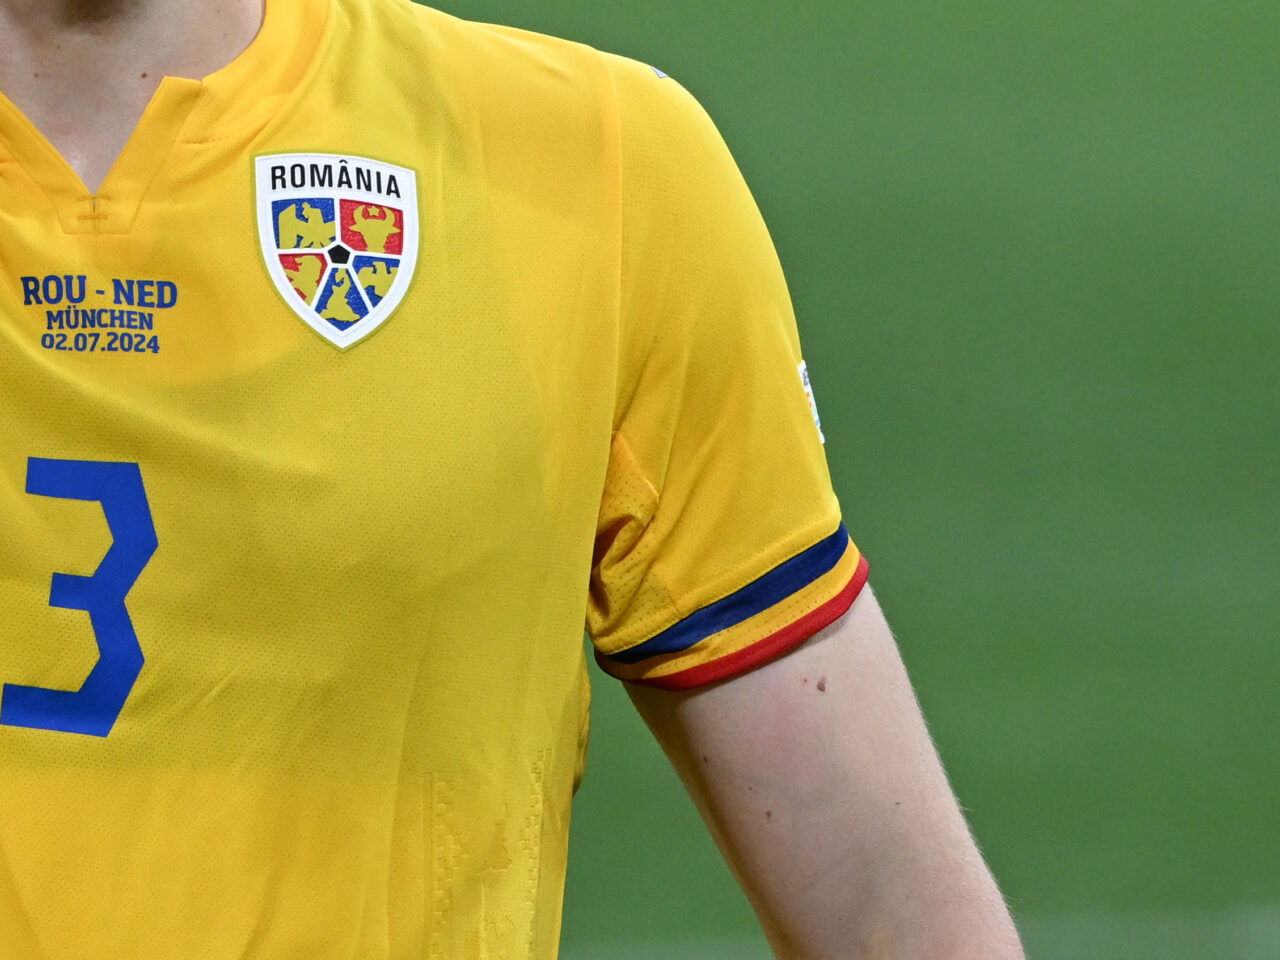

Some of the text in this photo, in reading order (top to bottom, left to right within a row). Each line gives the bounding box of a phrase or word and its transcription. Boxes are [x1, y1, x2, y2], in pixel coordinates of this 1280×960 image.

[271, 159, 401, 199] ROMÂNIA
[21, 275, 87, 306] ROU
[112, 279, 178, 309] NED
[46, 304, 154, 330] MÜNCHEN
[41, 332, 160, 354] 02.07.2024
[0, 456, 159, 738] 3
